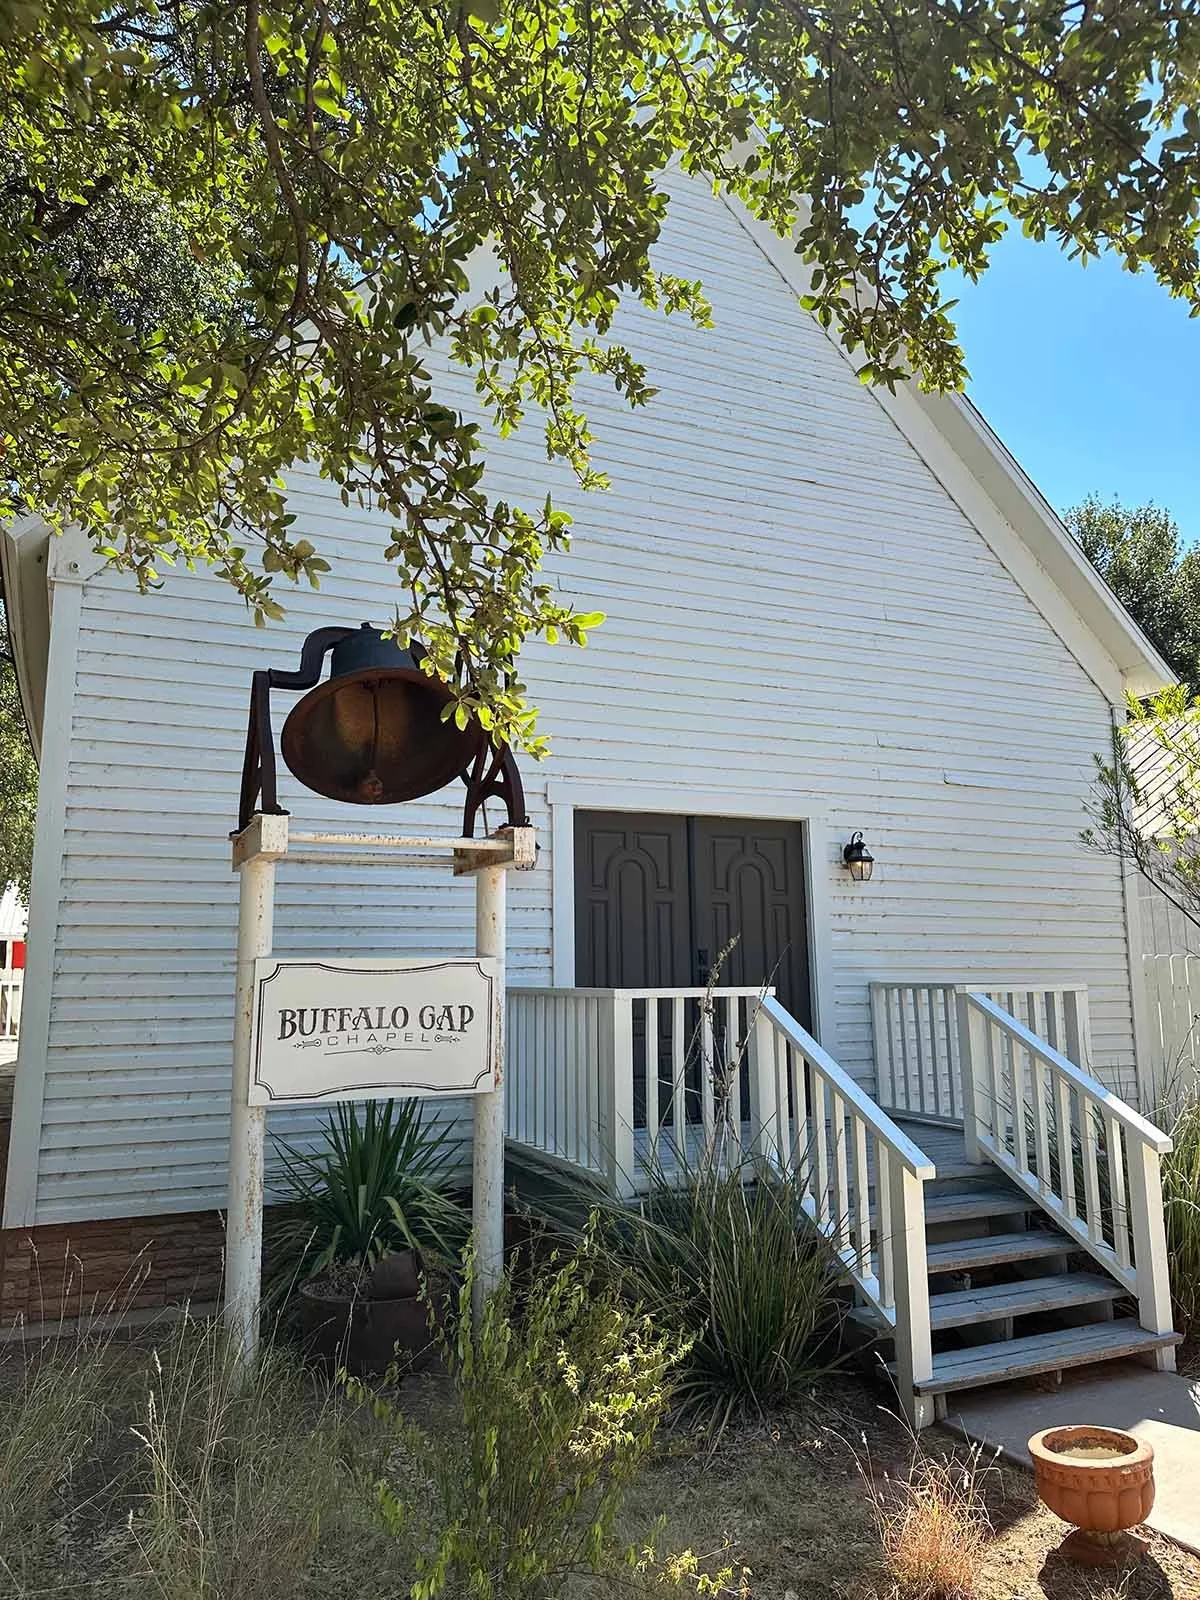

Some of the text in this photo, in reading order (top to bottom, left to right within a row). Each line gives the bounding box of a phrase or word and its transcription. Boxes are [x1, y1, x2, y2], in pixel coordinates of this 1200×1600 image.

[277, 1004, 475, 1041] BUFFALO GAP
[327, 1032, 430, 1047] CHAPEL
